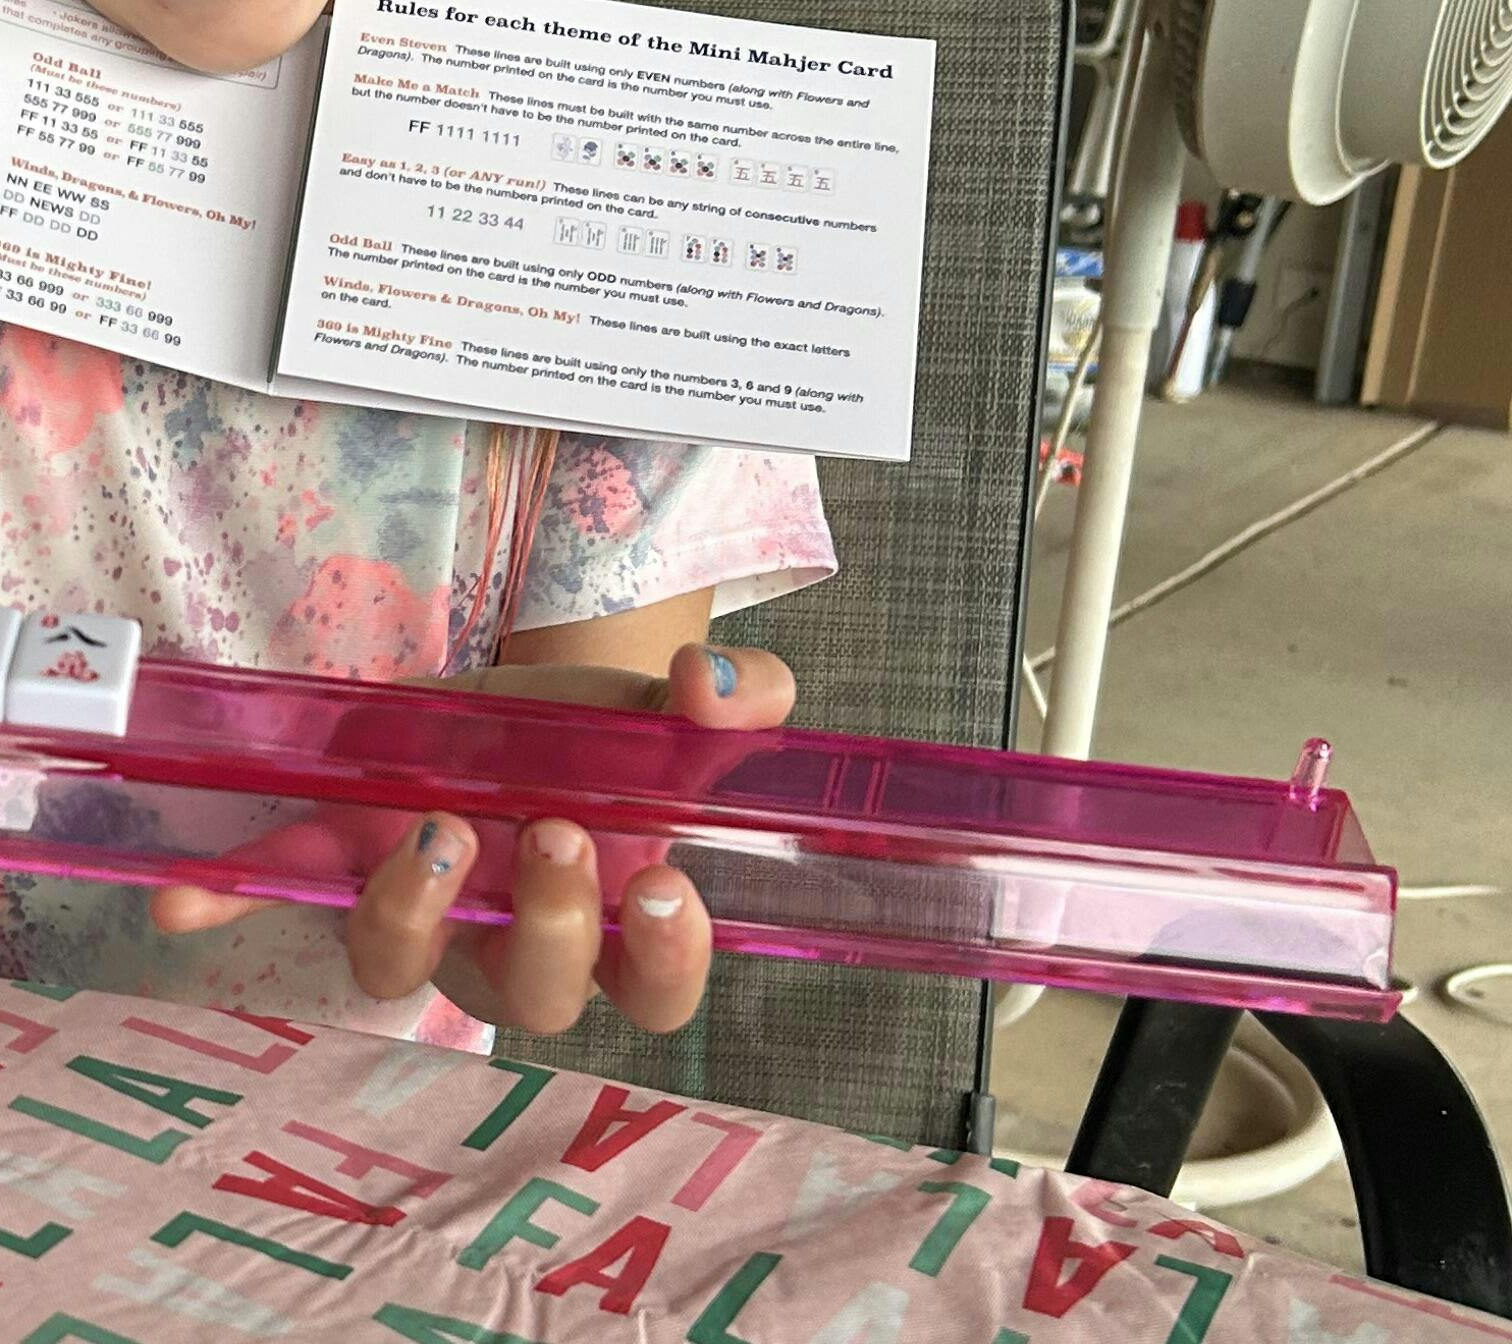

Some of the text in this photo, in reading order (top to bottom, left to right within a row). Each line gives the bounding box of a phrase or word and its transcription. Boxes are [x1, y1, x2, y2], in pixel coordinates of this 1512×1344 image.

[32, 52, 100, 79] Odd Ball
[444, 6, 478, 23] for
[484, 15, 535, 32] each
[543, 21, 611, 42] theme
[618, 32, 641, 46] of
[647, 35, 682, 52] the
[688, 40, 740, 60] Mini
[747, 48, 831, 72] Mahjer
[837, 60, 892, 78] Card
[356, 44, 772, 110] Dragons). The number printed on the card is the number you must use.
[360, 32, 394, 45] Even
[455, 44, 490, 58] These
[493, 49, 520, 62] lines
[523, 56, 542, 65] are
[545, 57, 570, 69] built
[574, 63, 605, 75] using
[608, 68, 633, 79] only
[636, 70, 670, 83] EVEN
[673, 77, 725, 90] numbers
[727, 83, 765, 96] (along
[768, 89, 792, 99] with
[795, 91, 843, 105] Flowers
[846, 99, 870, 108] and
[408, 119, 431, 133] FF
[6, 172, 109, 210] NN EE WW SS
[341, 152, 876, 232] Easy as 1, 2, 3 (or ANY run!) These lines can be any string of consecutive numbers
[427, 204, 523, 230] 11 22 33 44
[323, 275, 372, 292] Winds,
[377, 283, 436, 301] Flowers
[456, 295, 523, 315] Dragons,
[527, 306, 548, 318] Oh
[552, 309, 580, 323] My!
